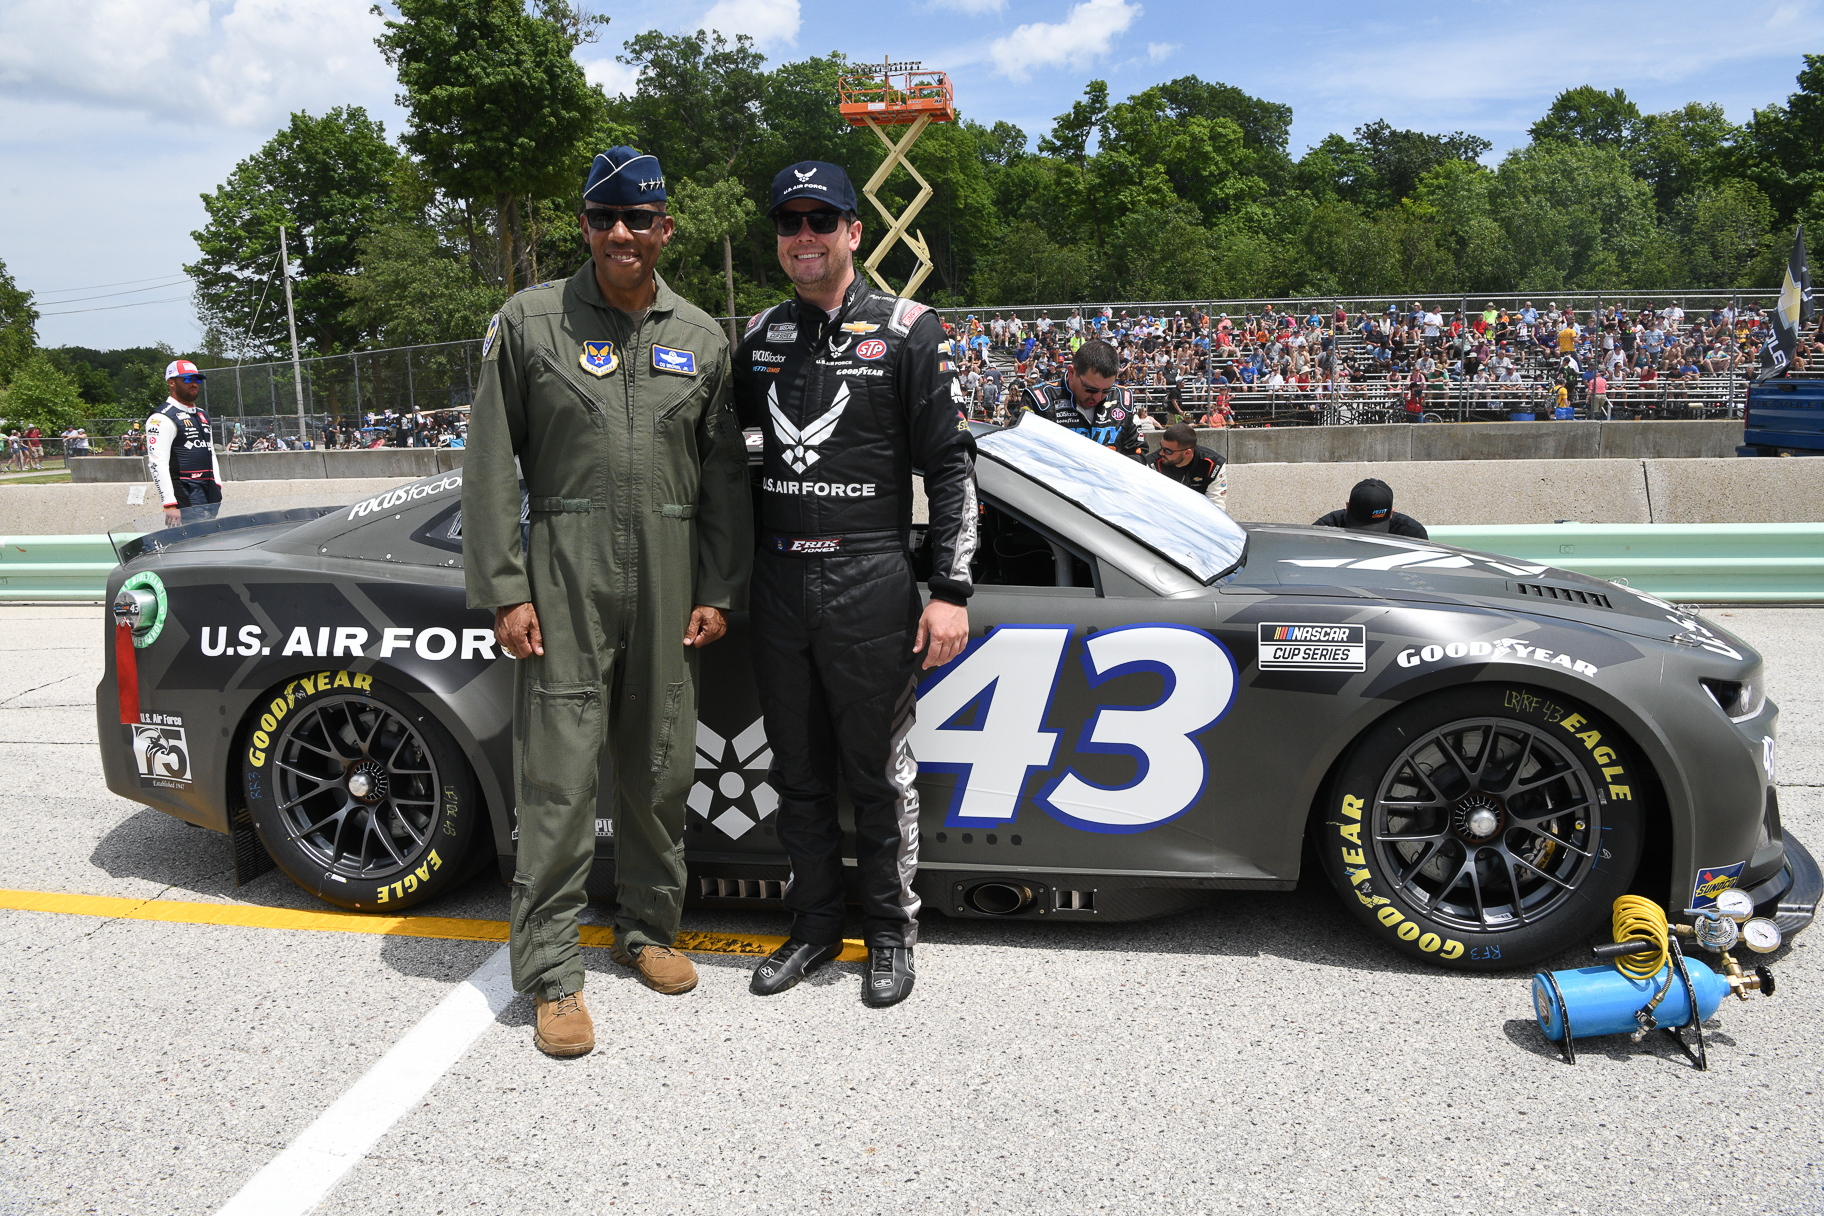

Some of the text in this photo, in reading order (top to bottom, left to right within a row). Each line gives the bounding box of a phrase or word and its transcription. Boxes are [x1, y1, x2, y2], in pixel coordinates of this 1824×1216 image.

[804, 183, 827, 191] FORCE
[859, 342, 884, 357] STP
[836, 367, 884, 376] GOODYEAR
[775, 481, 800, 495] AIR
[801, 482, 876, 497] FORCE
[789, 540, 840, 551] ERIK
[129, 604, 140, 614] 43
[200, 624, 519, 661] U.S. AIR FOR
[1290, 626, 1350, 642] NASCAR
[1272, 647, 1351, 662] CUP SERIES
[1396, 637, 1599, 678] GOODYEAR
[140, 713, 183, 726] U.S. Air Force
[249, 670, 374, 768] GOODYEAR
[1542, 701, 1564, 723] 43
[906, 622, 1240, 835] 43
[1559, 712, 1633, 801] EAGLE
[376, 848, 443, 904] EAGLE
[1340, 793, 1465, 960] GOODYEAR
[1697, 878, 1737, 896] SUNOCO
